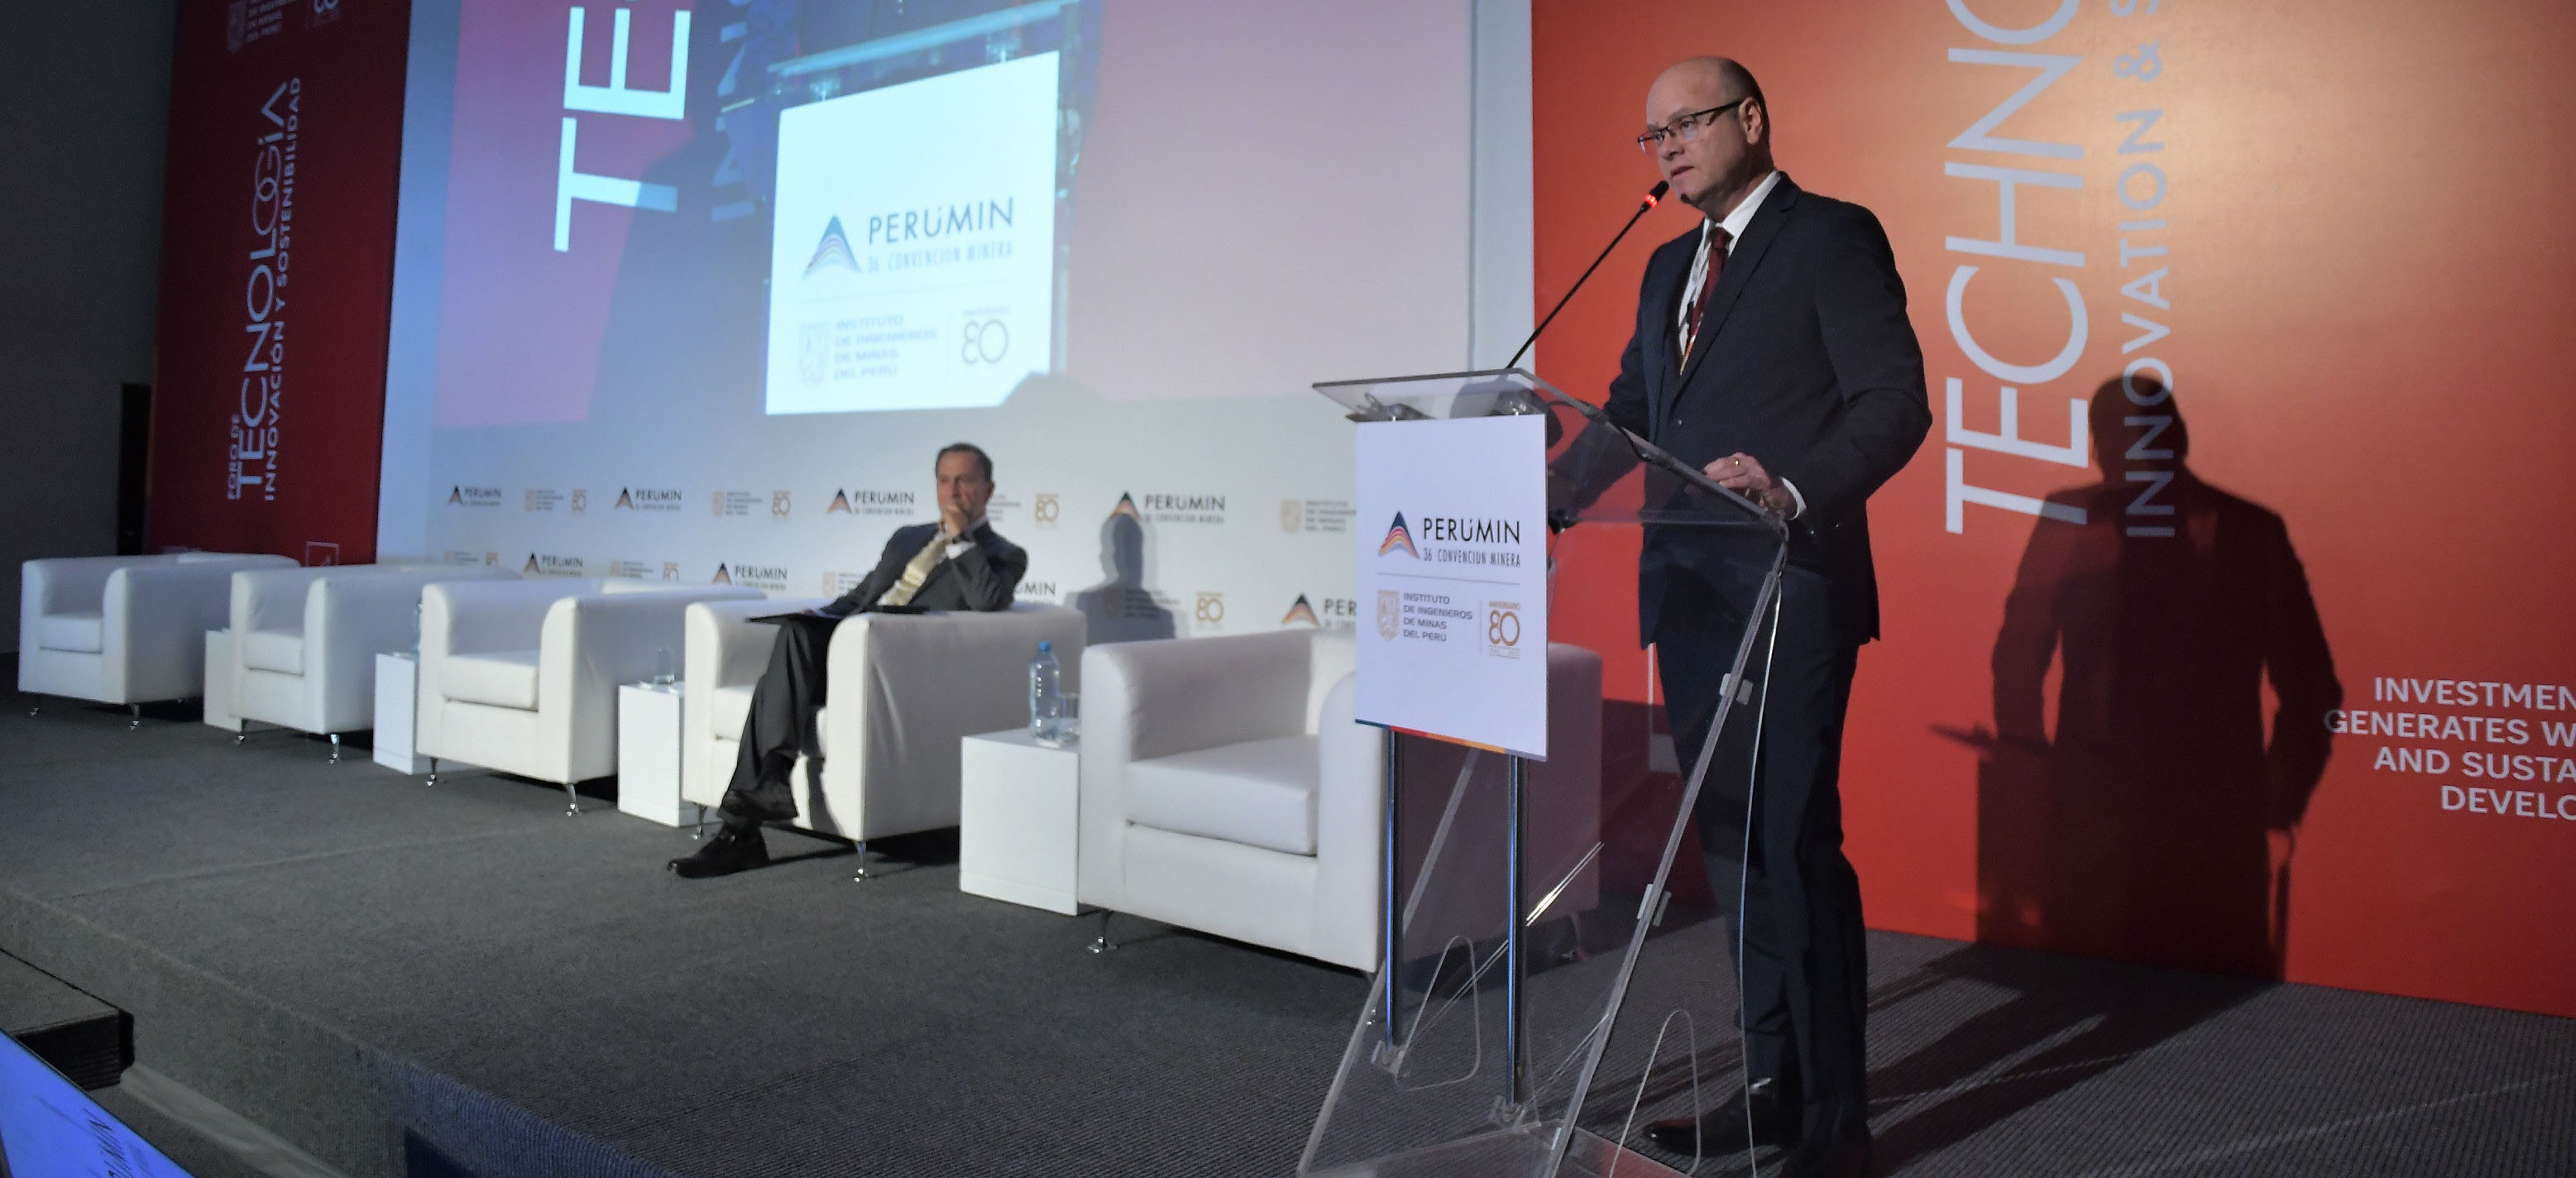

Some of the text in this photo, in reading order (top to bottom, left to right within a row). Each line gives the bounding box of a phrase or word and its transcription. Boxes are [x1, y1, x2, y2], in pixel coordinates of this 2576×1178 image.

[276, 77, 300, 287] SOSTENIBILIDAD
[275, 297, 286, 312] Y
[2113, 108, 2175, 538] INNOVATION
[1438, 548, 1487, 565] CONVENCION
[1491, 552, 1520, 567] MINERA
[1404, 592, 1450, 605] INSTITUTO
[1404, 605, 1473, 620] DE INGENIEROS
[1404, 617, 1448, 630] DE MINAS
[1404, 630, 1420, 639] DEL
[1489, 610, 1520, 646] 80
[2373, 677, 2576, 711] INVESTMEN
[2324, 709, 2530, 745] GENERATES
[2373, 746, 2576, 783] AND SUSTA
